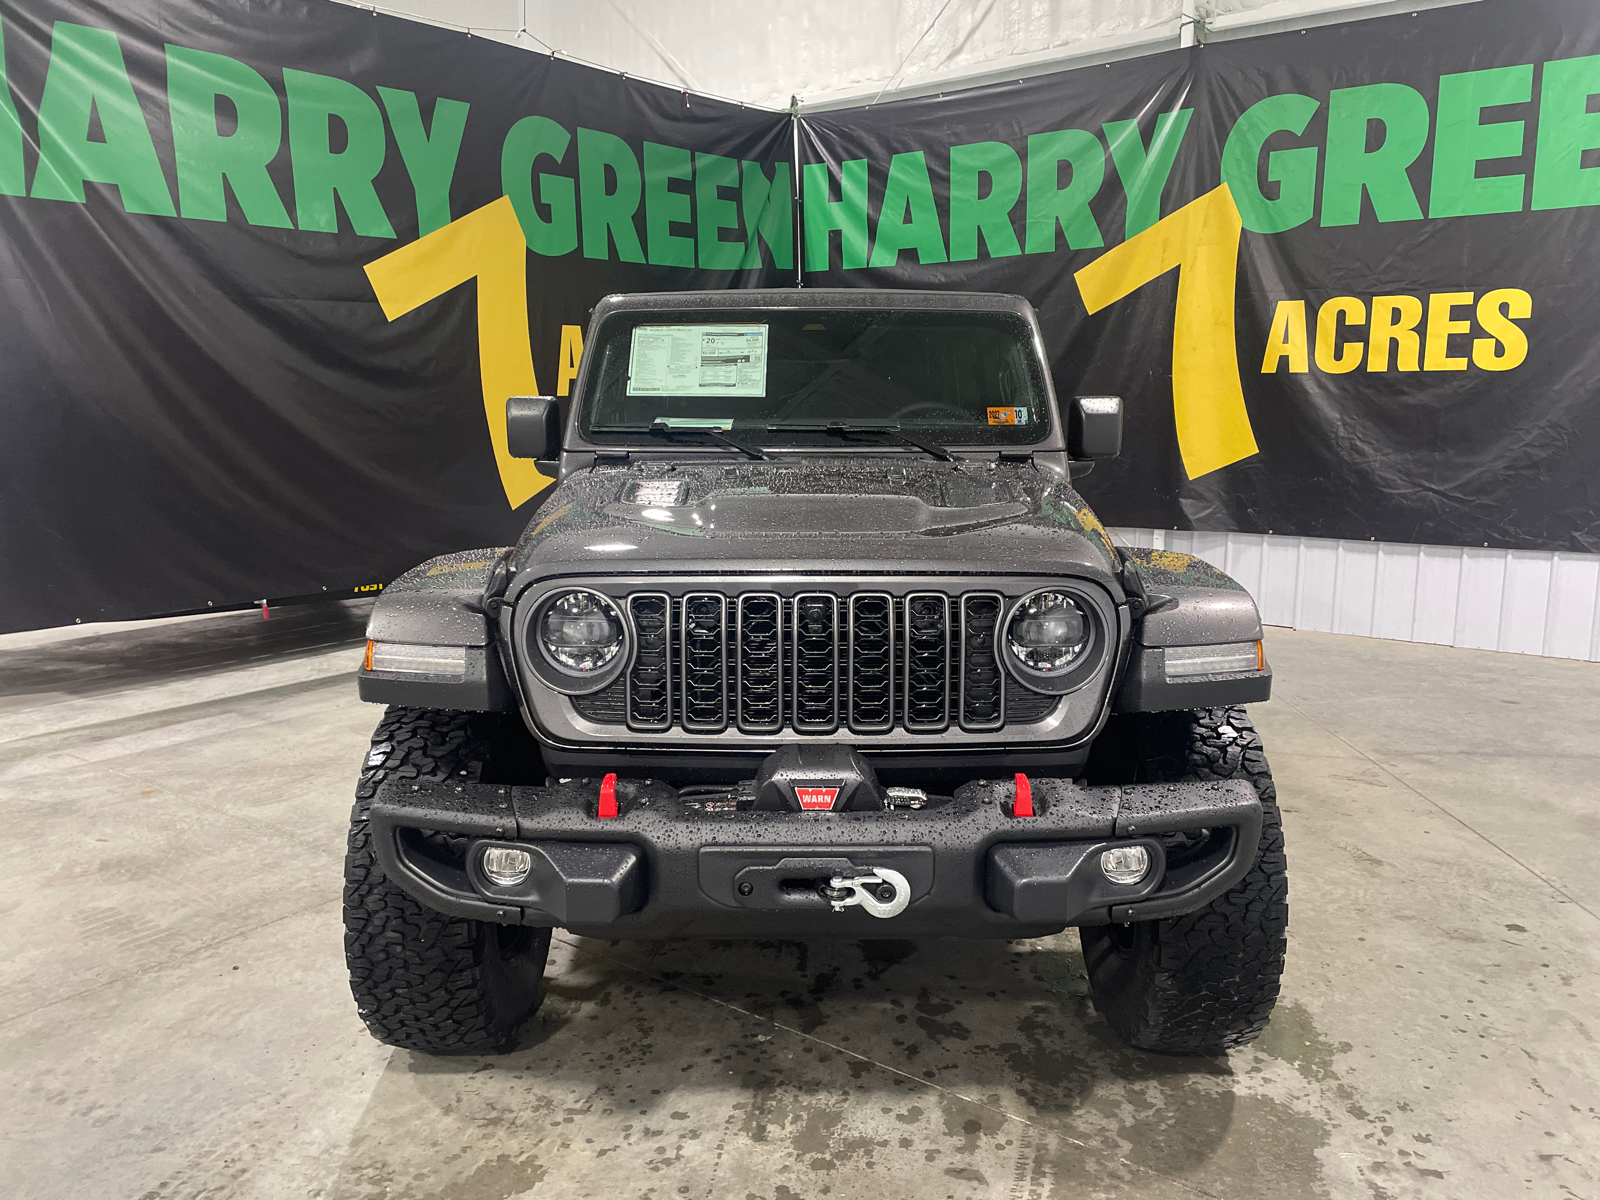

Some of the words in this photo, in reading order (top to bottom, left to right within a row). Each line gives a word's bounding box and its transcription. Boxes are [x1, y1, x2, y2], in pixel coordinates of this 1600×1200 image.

[501, 116, 794, 270] GREEN
[803, 109, 1194, 272] HARRY
[364, 195, 556, 510] 7
[1074, 183, 1259, 480] 7
[1260, 288, 1532, 374] ACRES
[1015, 409, 1022, 419] 10
[802, 794, 831, 804] WARN
